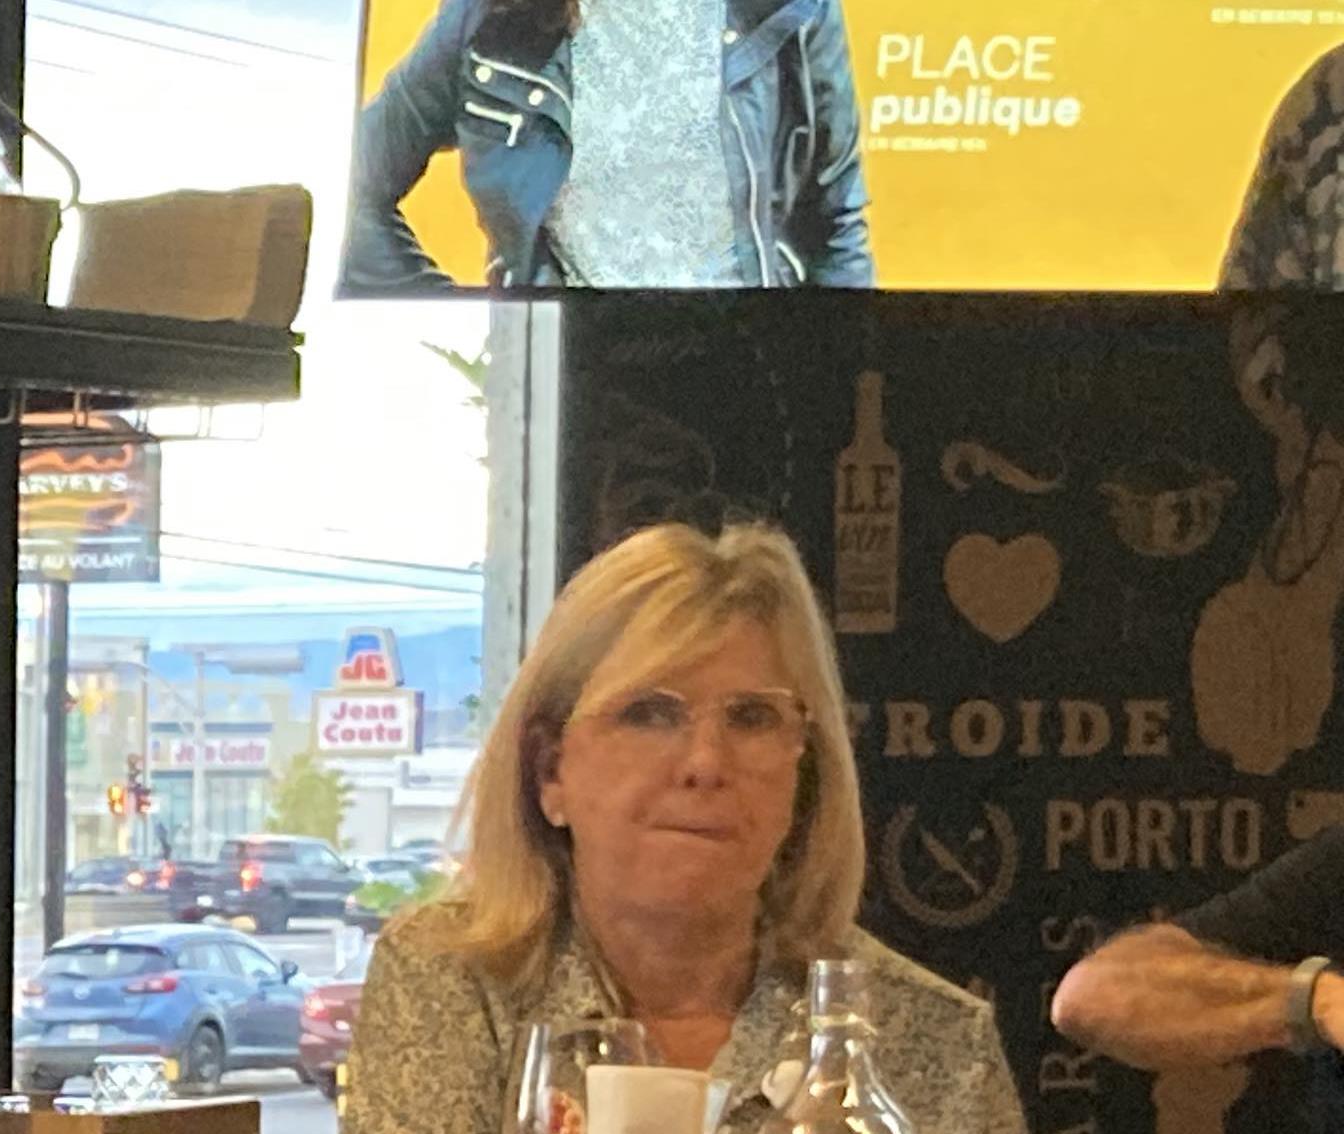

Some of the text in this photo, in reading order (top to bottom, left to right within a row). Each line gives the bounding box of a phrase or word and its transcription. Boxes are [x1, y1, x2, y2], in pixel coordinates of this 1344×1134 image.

[876, 35, 1056, 80] PLACE
[870, 87, 1081, 135] publique
[69, 552, 136, 570] VOLANT
[331, 701, 397, 721] Jean
[323, 722, 403, 743] Coutu
[1046, 799, 1262, 872] PORTO
